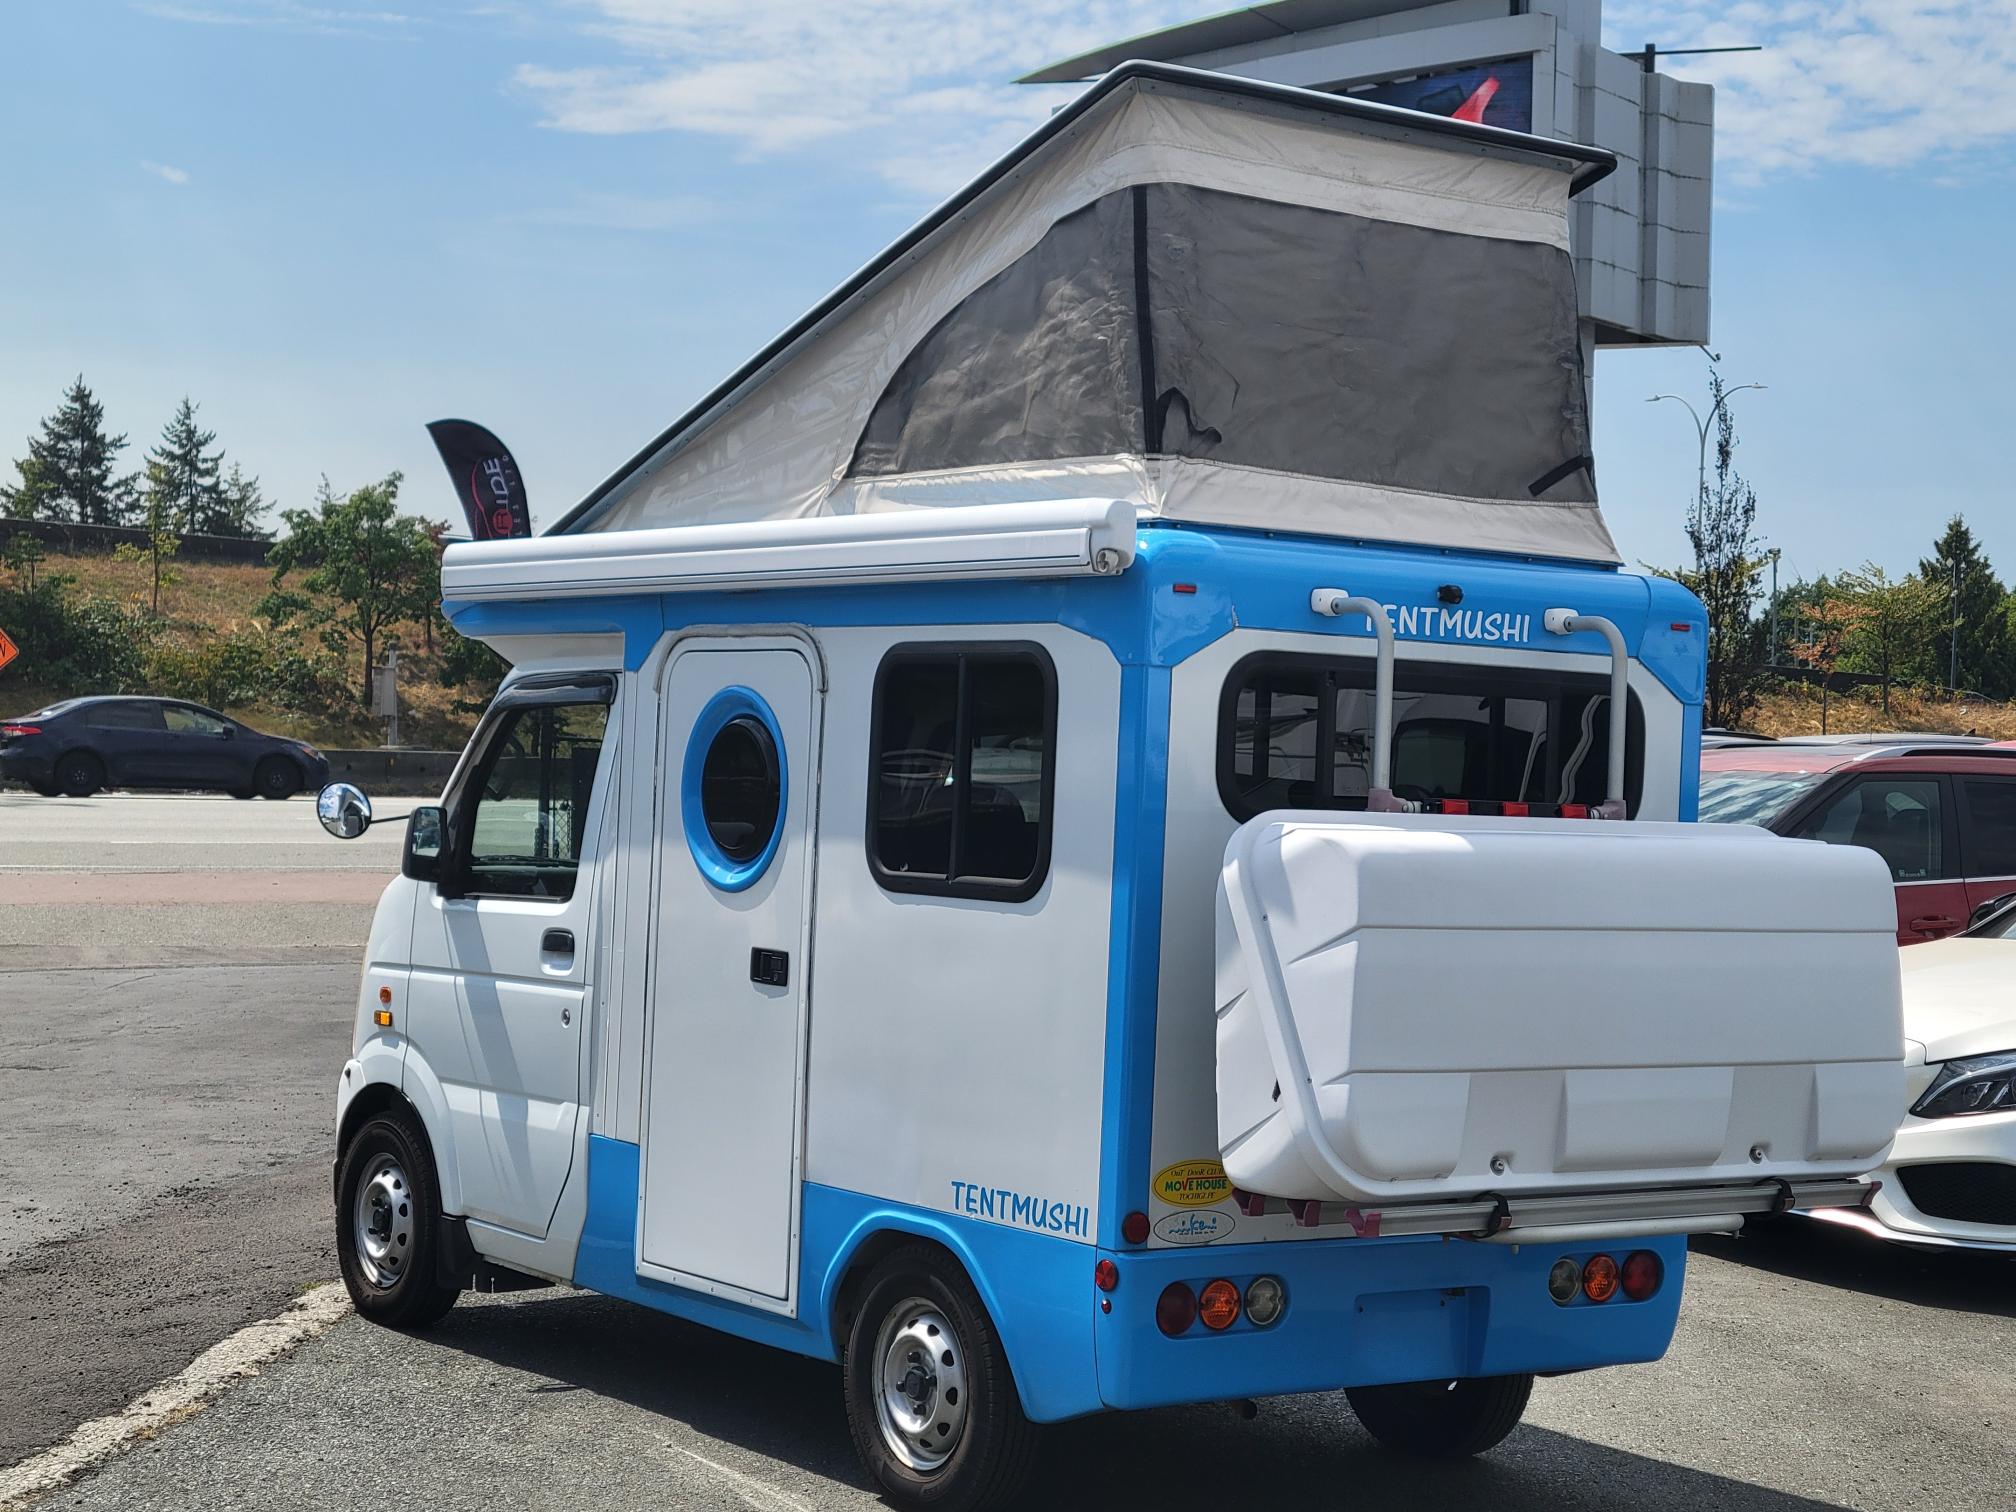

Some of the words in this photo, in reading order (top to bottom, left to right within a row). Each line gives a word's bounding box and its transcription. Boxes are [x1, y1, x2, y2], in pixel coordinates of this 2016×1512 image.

[1165, 1178, 1194, 1192] MOVE
[1196, 1179, 1227, 1191] HOUSE
[951, 1181, 1089, 1237] TENTMUSHI
